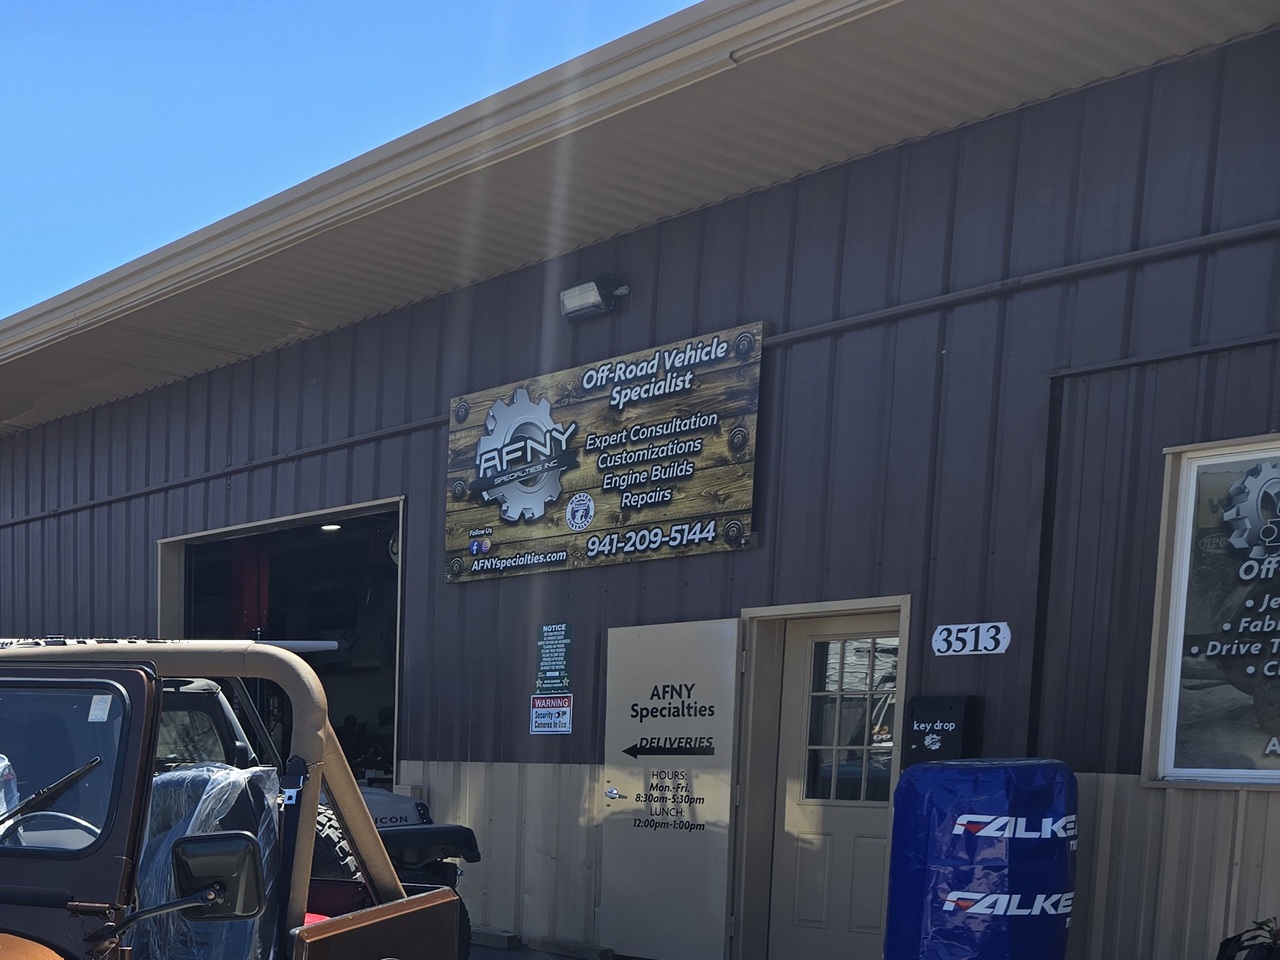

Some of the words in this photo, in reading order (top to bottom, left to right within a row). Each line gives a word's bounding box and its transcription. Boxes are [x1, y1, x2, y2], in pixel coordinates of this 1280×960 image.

[582, 353, 659, 389] Off-Road
[664, 337, 728, 372] Vehicle
[610, 371, 694, 409] Specialist
[586, 429, 628, 450] Expert
[630, 413, 718, 441] Consultation
[480, 423, 576, 478] AFNY
[598, 439, 702, 469] Customizations
[494, 464, 542, 485] SPECIALTIES
[544, 459, 558, 469] INC
[603, 471, 648, 490] Engine
[651, 461, 694, 481] Builds
[621, 488, 672, 508] Repairs
[469, 529, 485, 537] Follow
[586, 520, 716, 558] 941-209-5144
[471, 551, 567, 571] AFNYspecialties.com
[543, 624, 566, 632] NOTICE
[937, 625, 1002, 654] 3513
[1206, 640, 1262, 656] Drive
[650, 683, 696, 700] AFNY
[535, 698, 568, 708] WARNING
[535, 710, 553, 720] Security
[630, 701, 715, 723] Specialties
[535, 720, 552, 729] Cameras
[558, 721, 567, 729] Use
[913, 720, 932, 733] key
[933, 720, 956, 732] drop
[639, 737, 714, 749] DELIVERIES
[651, 770, 687, 781] HOURS:
[649, 782, 690, 793] Mon.-Fri.
[635, 793, 705, 807] 8:30am-5:30pm
[650, 807, 686, 818] LUNCH:
[633, 818, 705, 833] 12:00pm-1:00pm
[952, 814, 1077, 839] FALKE
